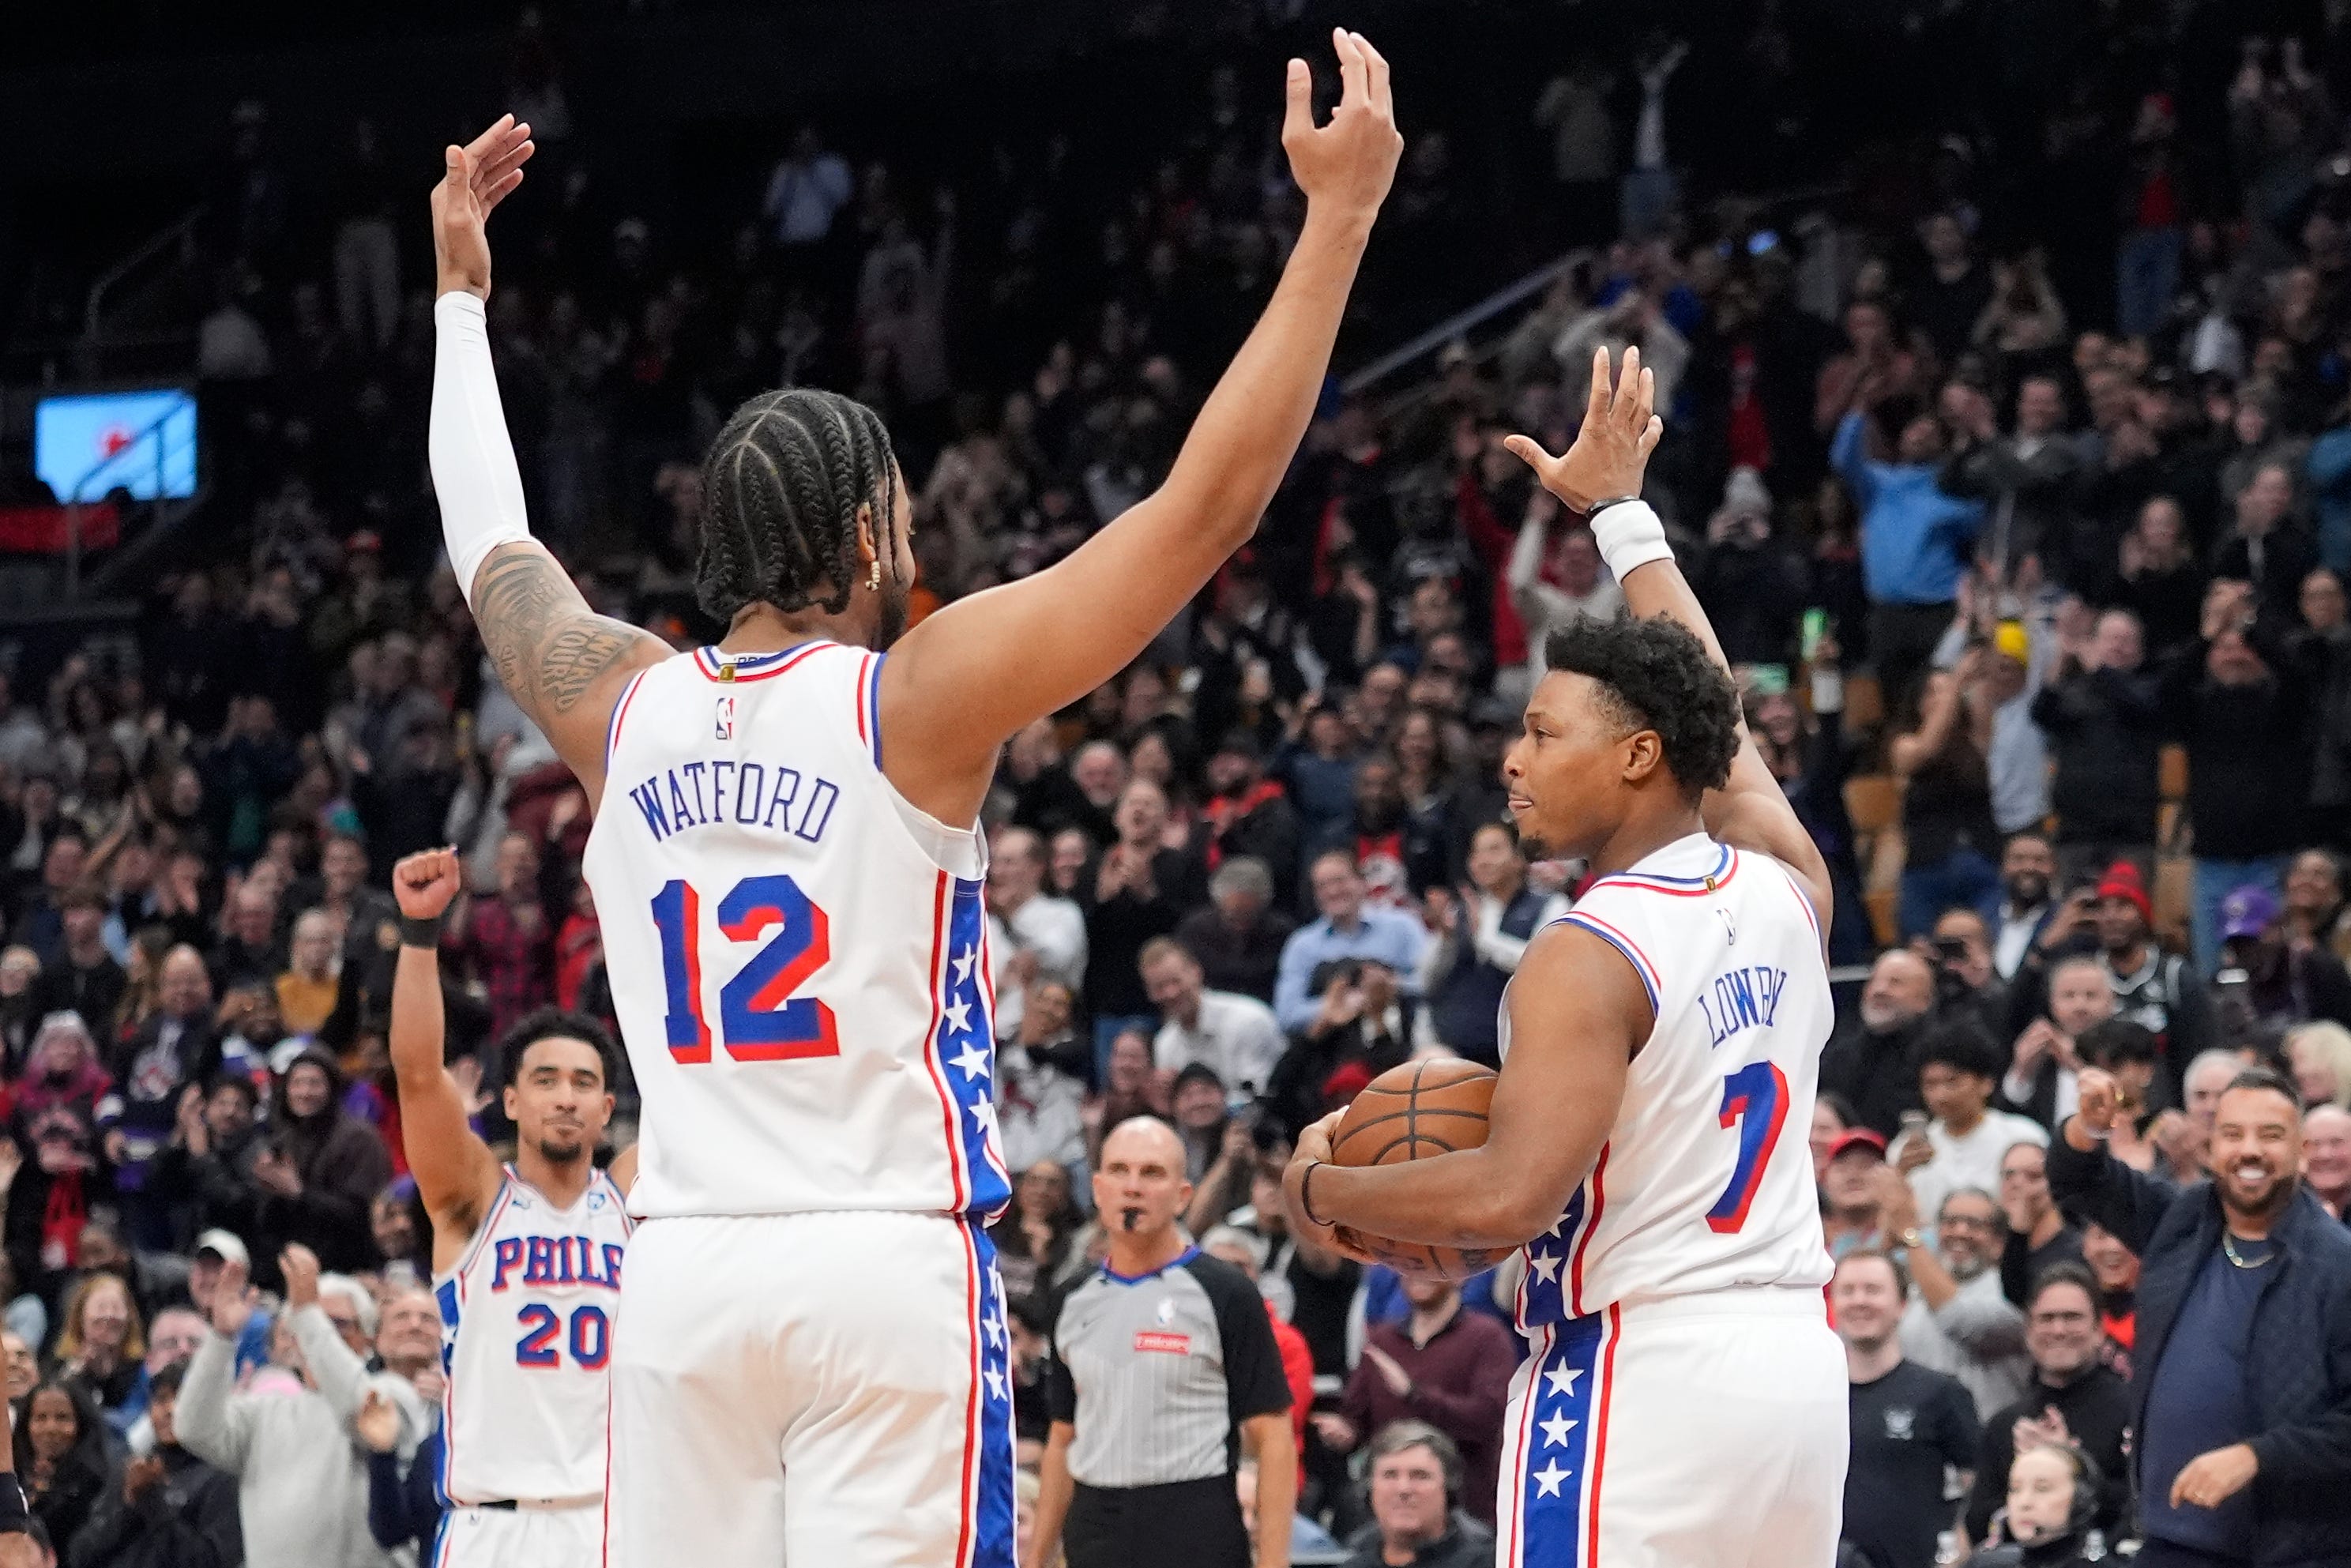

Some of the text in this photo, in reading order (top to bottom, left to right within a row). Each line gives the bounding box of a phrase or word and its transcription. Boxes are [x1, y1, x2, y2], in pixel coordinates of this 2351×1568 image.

[630, 761, 840, 843] WATFORD
[651, 874, 840, 1064] 12
[1698, 966, 1787, 1050] LOWRY
[1705, 1060, 1789, 1234] 7
[517, 1303, 609, 1371] 20
